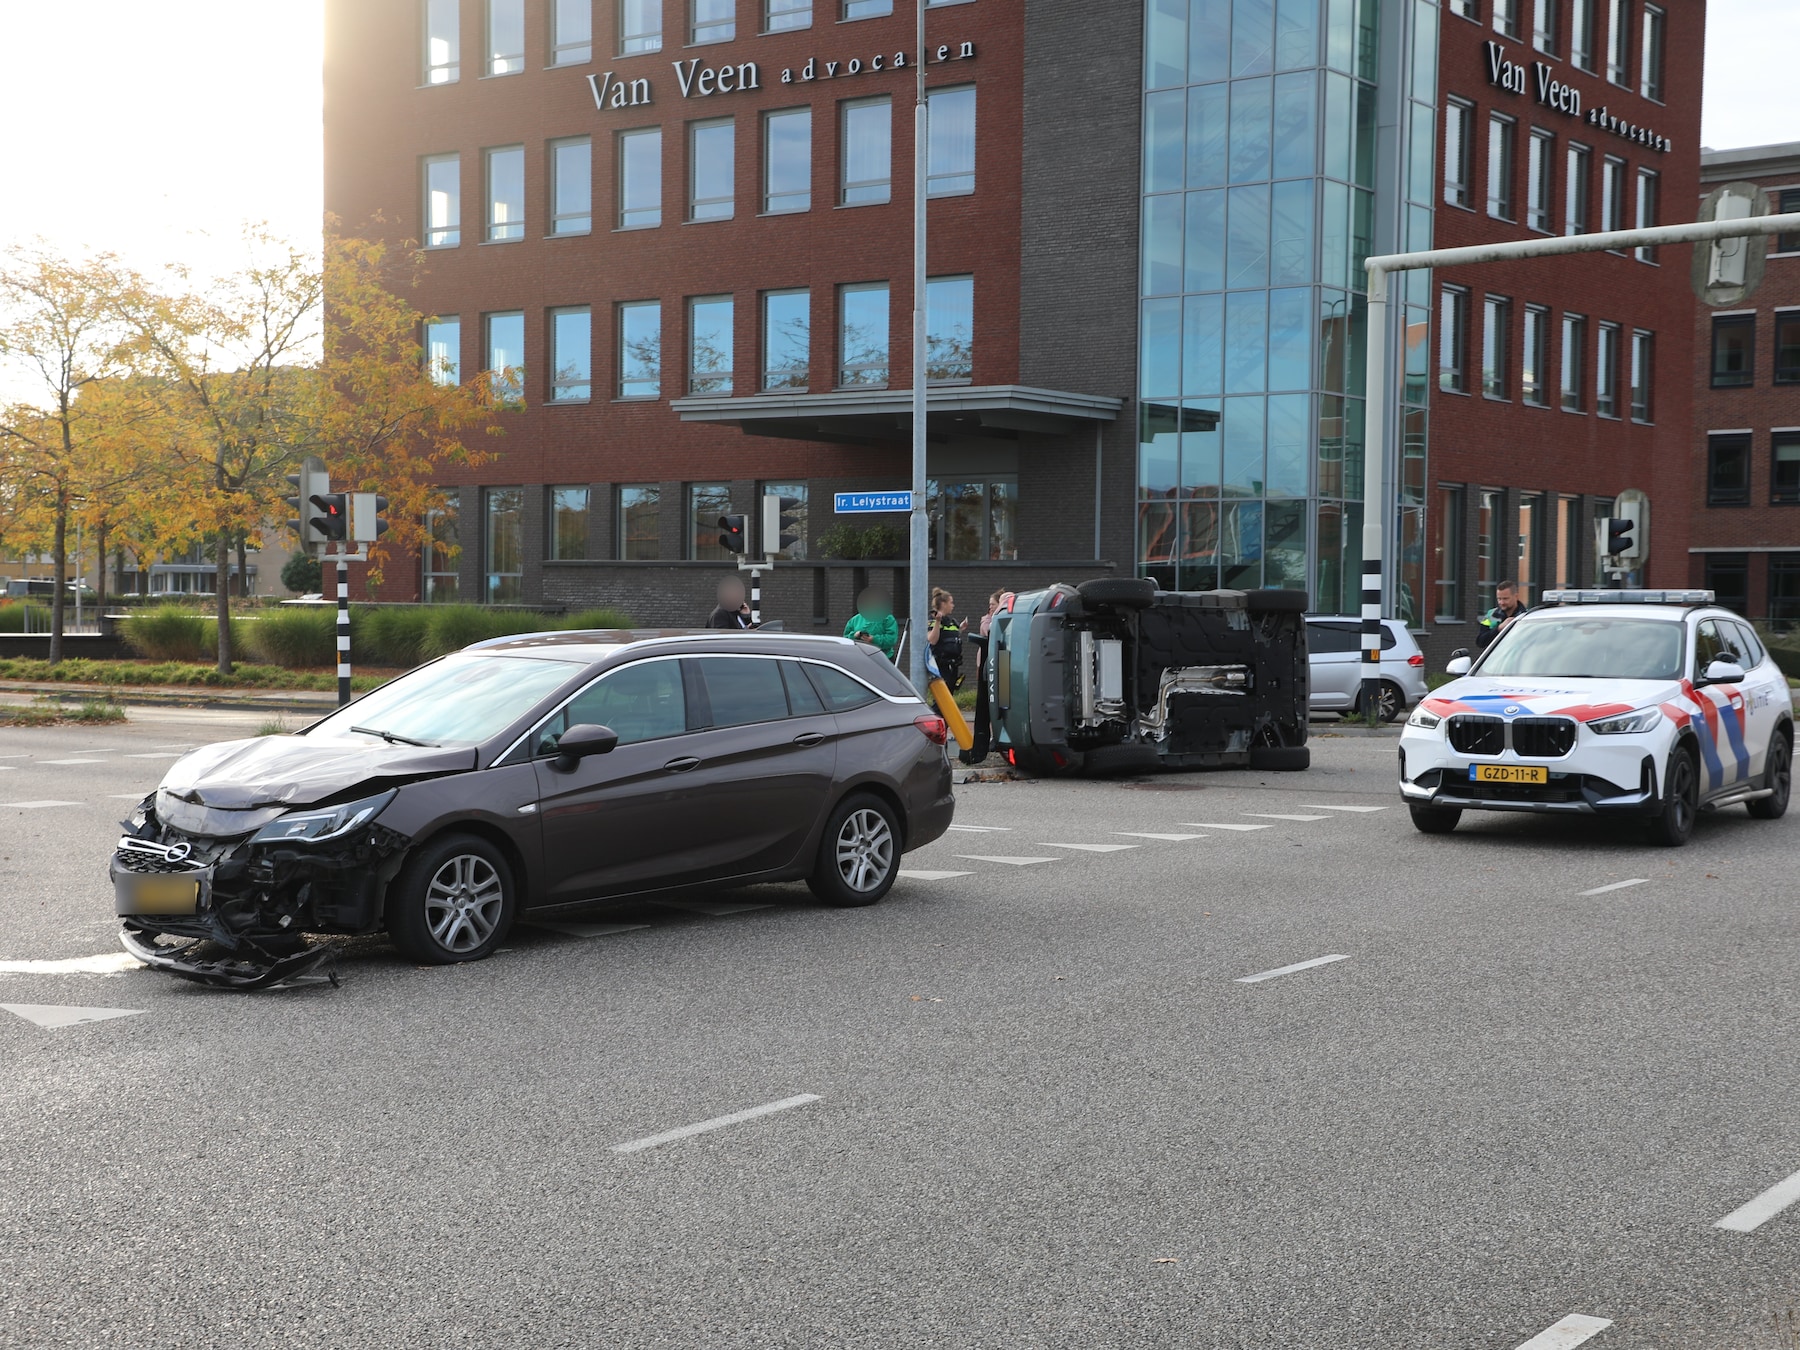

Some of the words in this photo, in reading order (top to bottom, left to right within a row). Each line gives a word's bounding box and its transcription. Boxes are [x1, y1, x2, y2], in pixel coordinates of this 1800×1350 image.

[586, 71, 651, 111] Van
[672, 57, 759, 99] Veen
[781, 40, 974, 84] advocaen
[1488, 40, 1526, 95] Van
[1536, 61, 1581, 116] Veen
[1589, 106, 1672, 153] advocaten
[837, 497, 848, 507] Ir.
[852, 495, 910, 508] Lelystraat
[1483, 767, 1539, 781] GZD-11-R
